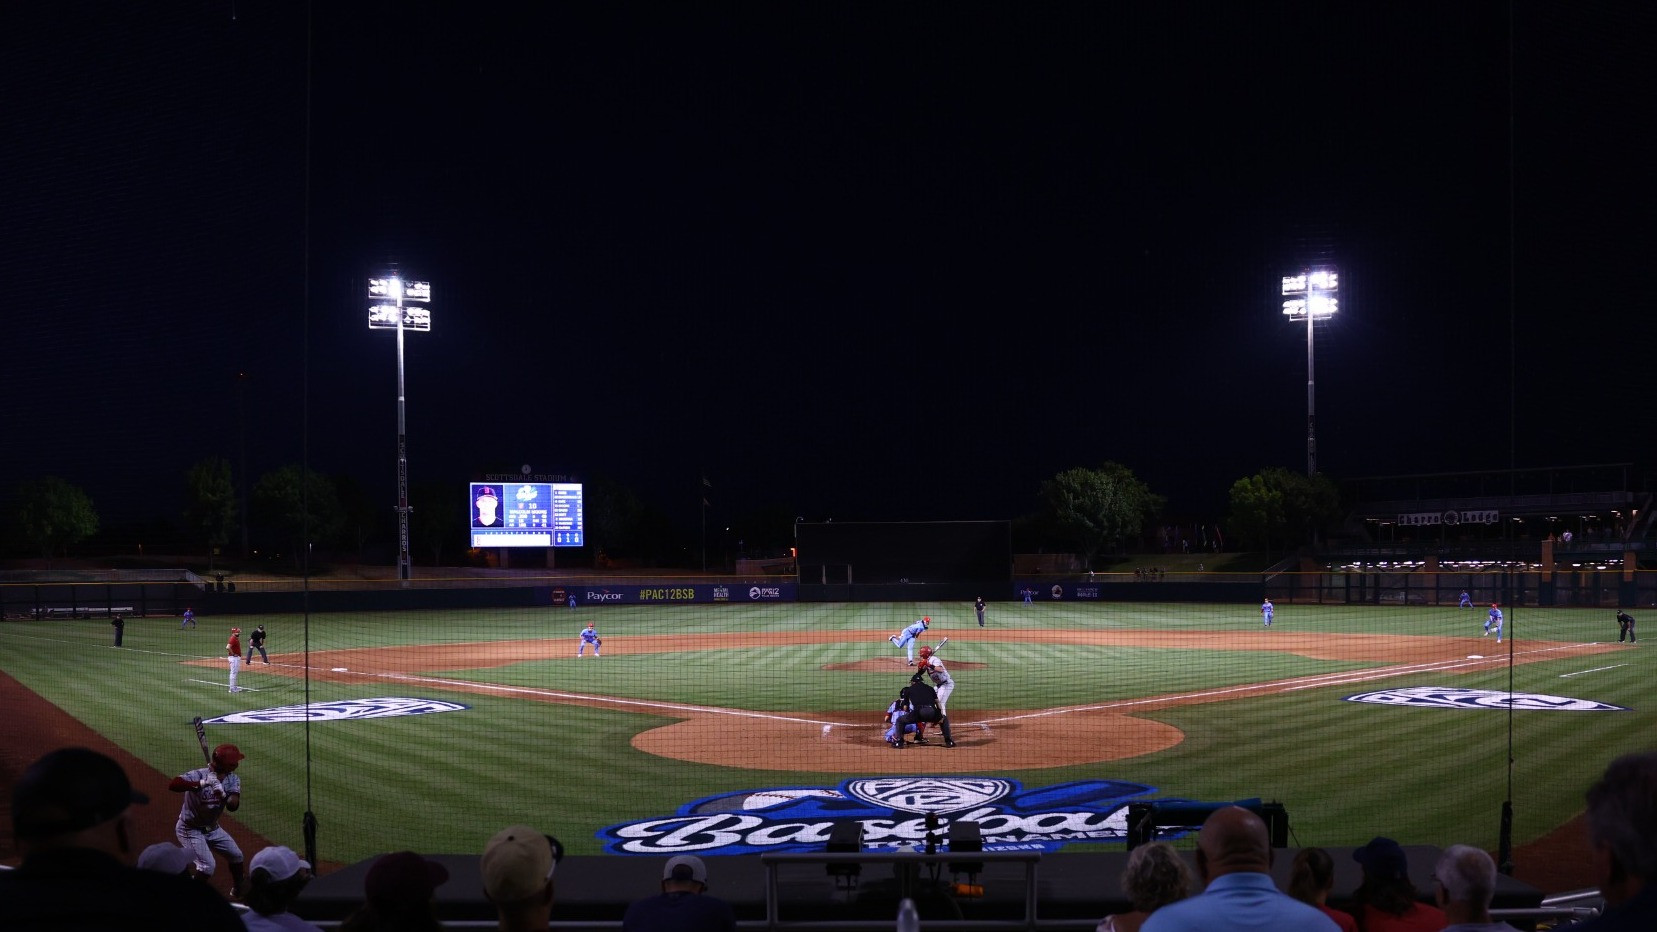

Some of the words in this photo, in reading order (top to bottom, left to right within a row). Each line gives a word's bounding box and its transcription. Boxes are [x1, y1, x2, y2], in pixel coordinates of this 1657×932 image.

[486, 474, 532, 482] SCOTTSDALE
[534, 474, 567, 482] STADIUM
[1399, 515, 1439, 524] Charro
[1463, 512, 1498, 523] Lodge
[587, 592, 624, 602] Paycor
[639, 588, 695, 600] #PAC12BSB
[616, 806, 1129, 853] Baseba
